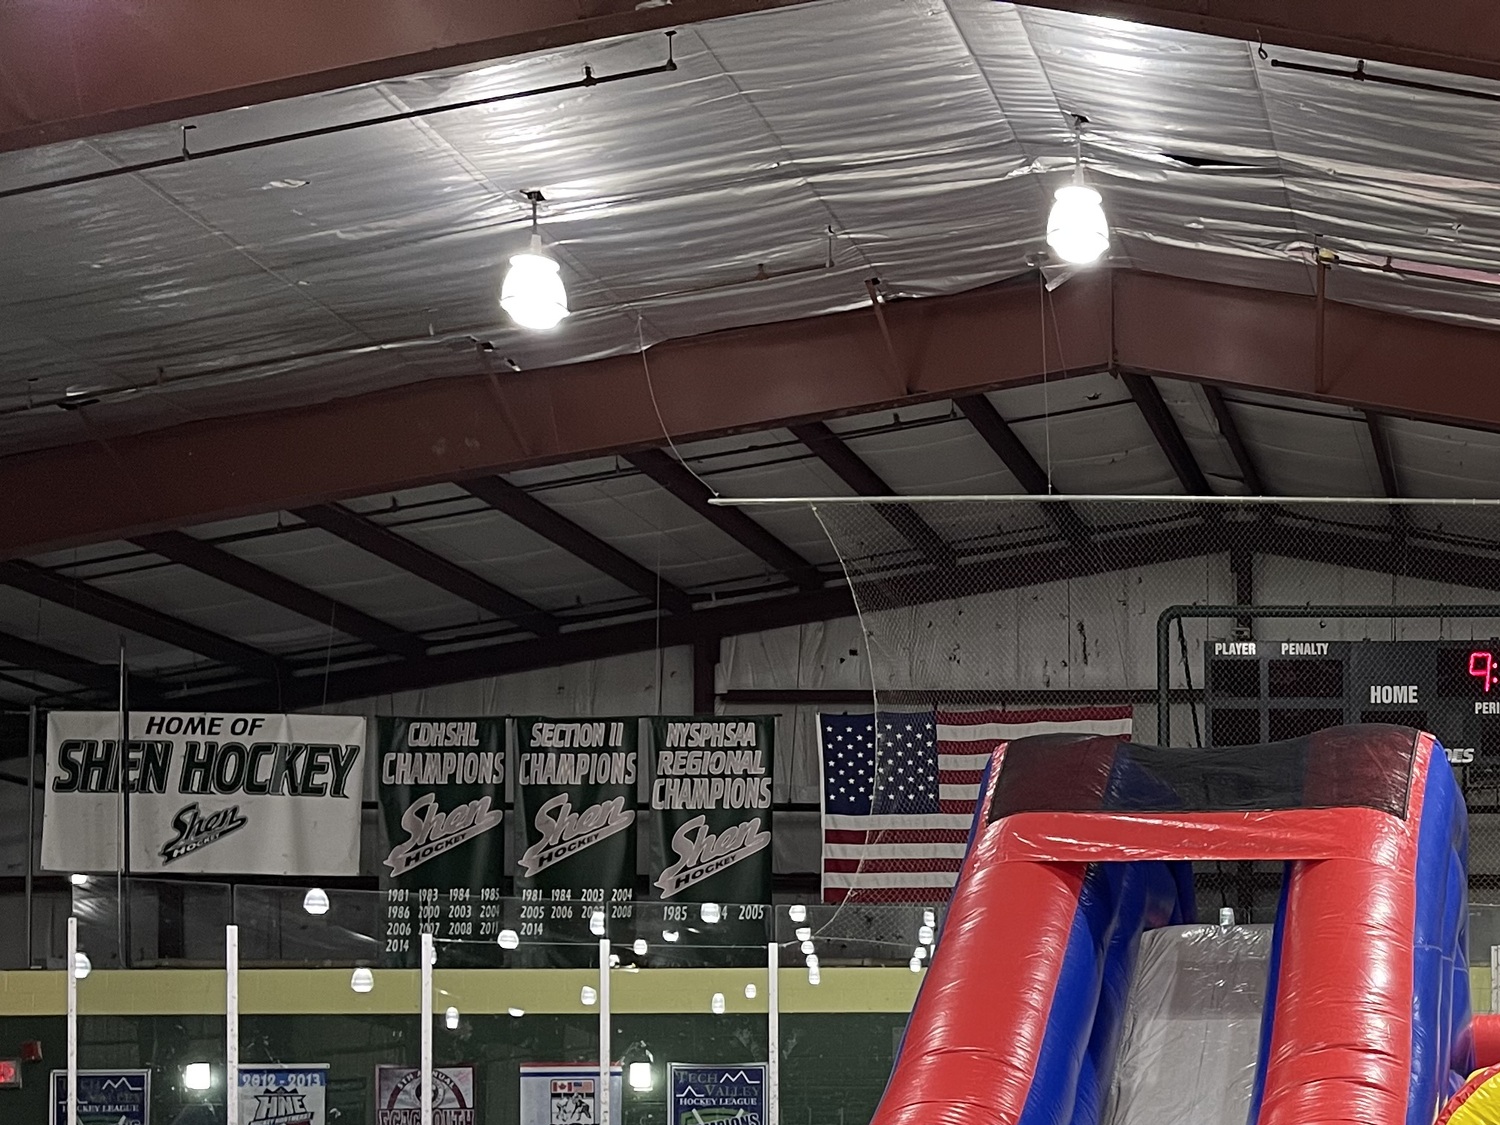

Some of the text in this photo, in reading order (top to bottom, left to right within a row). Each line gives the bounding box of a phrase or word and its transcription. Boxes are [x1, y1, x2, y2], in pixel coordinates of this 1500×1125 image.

[1214, 643, 1329, 656] PLAYER PENALTY
[1370, 685, 1418, 704] HOME
[145, 716, 265, 736] HOME OF
[408, 722, 479, 747] CDHSHL
[530, 722, 624, 748] SECTION II
[665, 722, 757, 748] NYSPHSAA
[52, 740, 361, 799] SHEN HOCKEY
[382, 752, 505, 785] CHAMPIONS
[519, 752, 637, 785] CHAMPIONS
[657, 750, 766, 776] REGIONAL
[651, 777, 772, 810] CHAMPIONS
[165, 801, 248, 852] Shen
[393, 793, 503, 862] Shen
[527, 793, 635, 862] Shen
[173, 833, 220, 857] HOCKEY
[404, 833, 466, 867] HOCKEY
[538, 833, 599, 867] HOCKEY
[664, 815, 771, 883] Shen
[675, 855, 736, 889] HOCKEY
[388, 889, 409, 902] 1981
[449, 888, 470, 901] 1984
[480, 887, 500, 901] 1985
[522, 888, 633, 902] 1981 1984 2003 2004
[388, 906, 410, 919] 1986
[448, 905, 472, 918] 2003
[520, 906, 545, 919] 2005
[550, 906, 573, 919] 2006
[663, 906, 687, 920] 1985
[738, 905, 764, 919] 2005
[386, 922, 411, 936] 2006
[448, 922, 472, 935] 2008
[520, 922, 543, 936] 2014
[385, 939, 409, 952] 2014
[242, 1073, 276, 1087] 2012
[288, 1073, 320, 1086] 2013
[675, 1070, 717, 1083] TECH
[705, 1084, 760, 1097] VALLEY
[720, 1097, 757, 1105] LEAGUE
[254, 1095, 307, 1120] HNE
